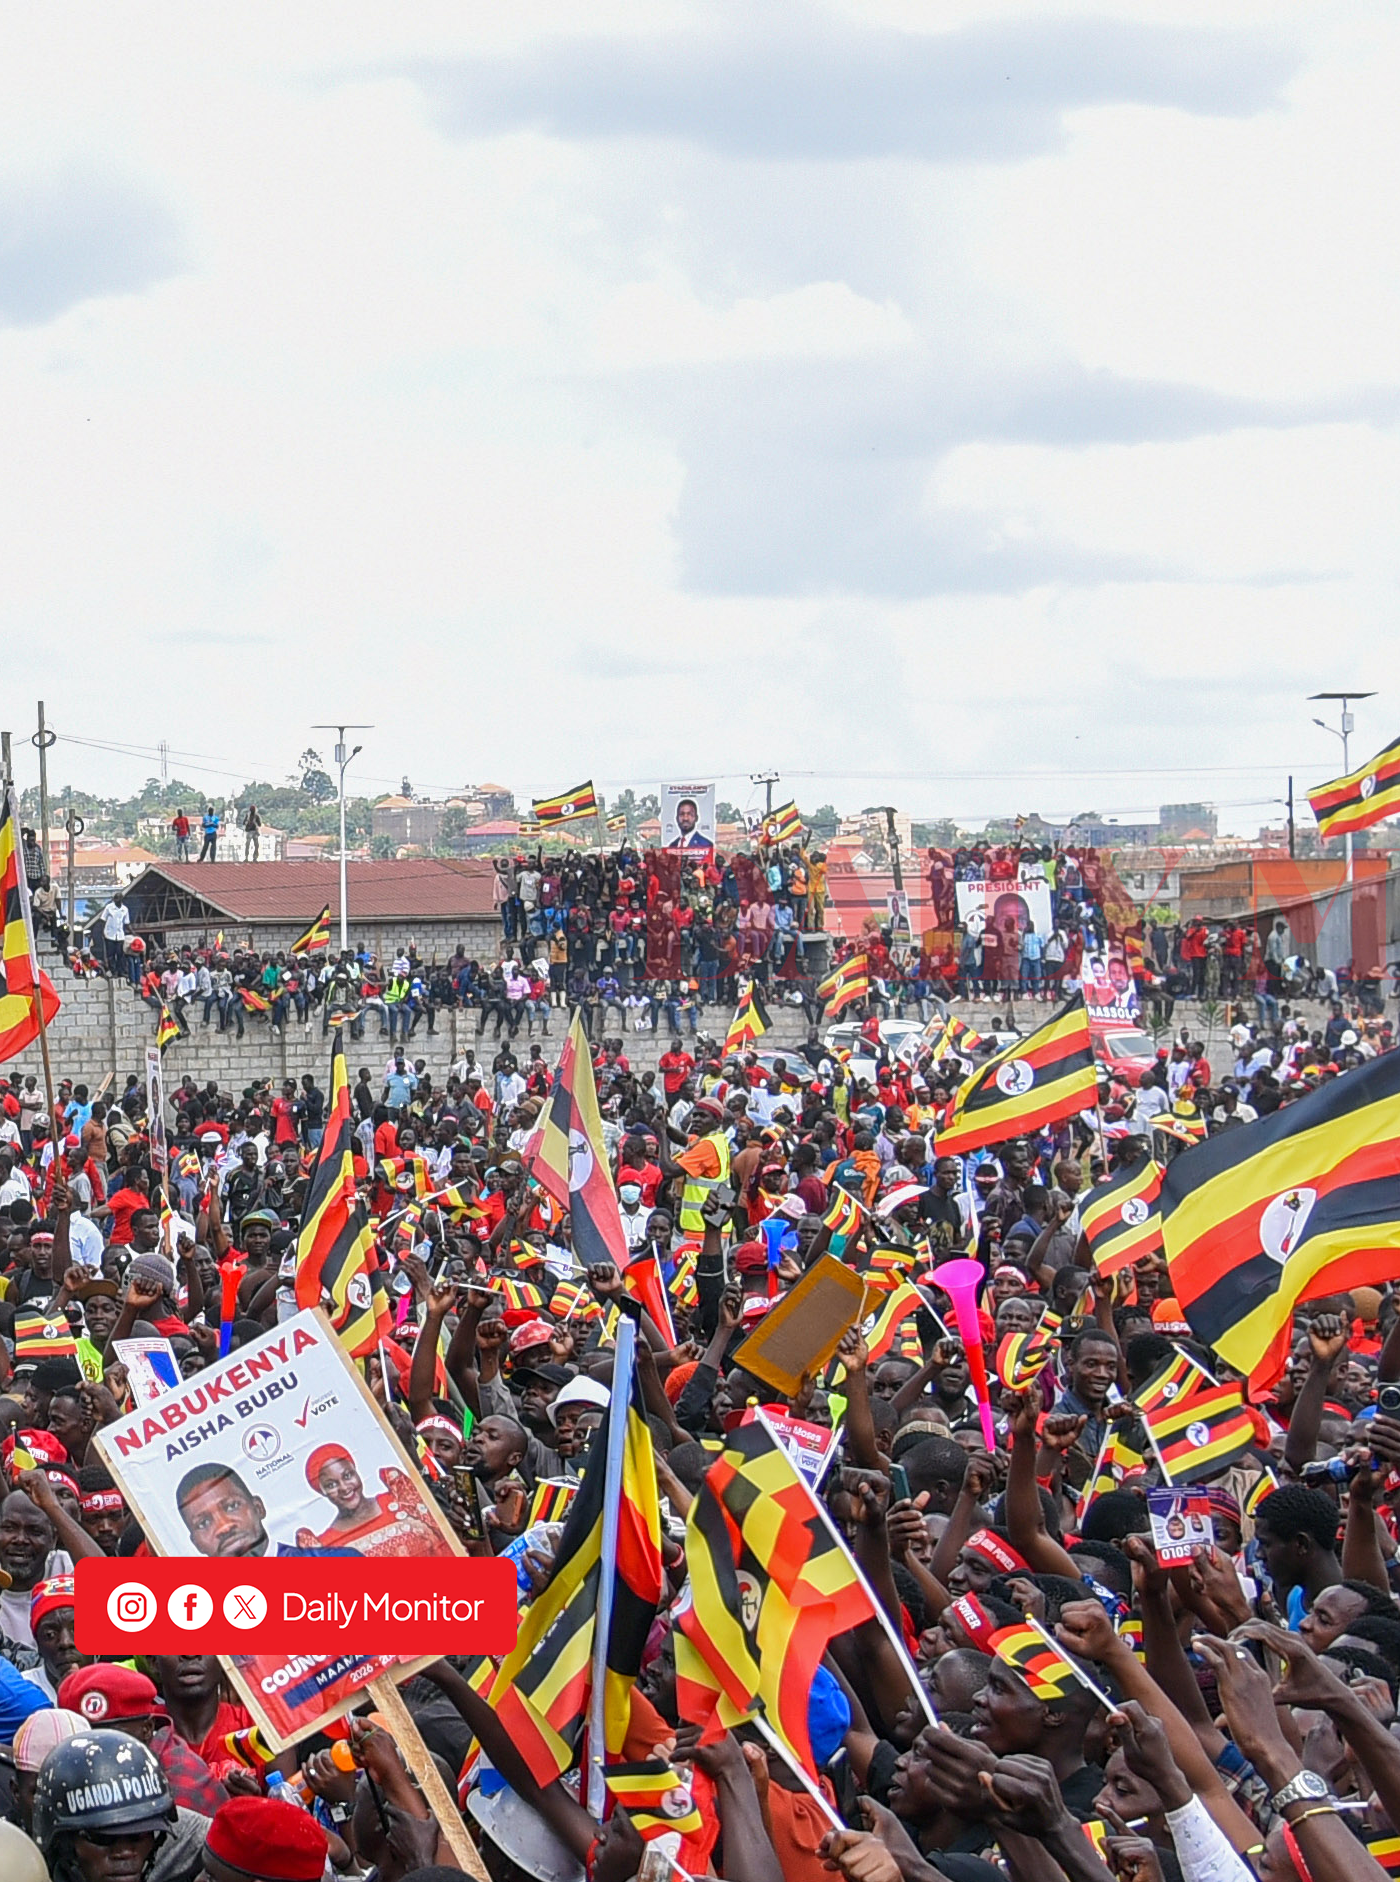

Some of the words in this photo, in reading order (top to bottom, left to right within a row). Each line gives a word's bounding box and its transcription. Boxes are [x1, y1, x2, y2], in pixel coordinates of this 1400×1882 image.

[968, 881, 1041, 893] PRESIDENT
[114, 1328, 319, 1457] NABUKENYA
[165, 1413, 234, 1462] AISHA
[235, 1371, 299, 1419] BUBU
[310, 1396, 339, 1416] VOTE
[992, 1547, 1016, 1571] POWER
[349, 1663, 374, 1683] 2026
[66, 1778, 124, 1814] UGANDA
